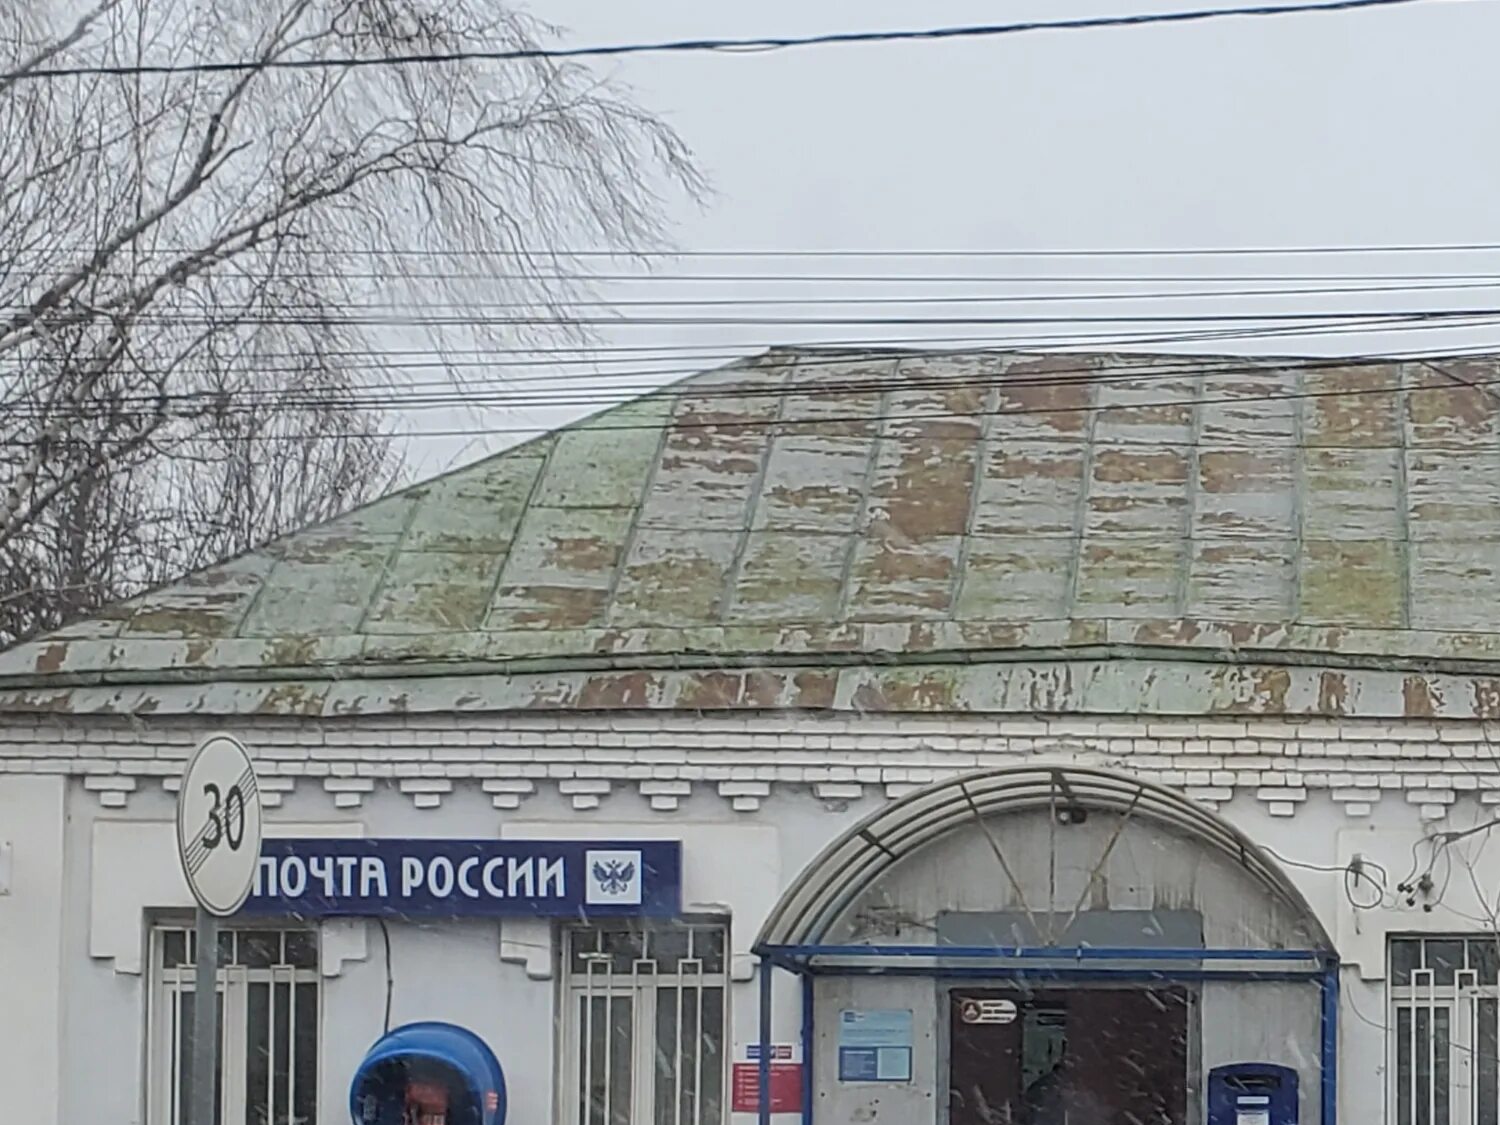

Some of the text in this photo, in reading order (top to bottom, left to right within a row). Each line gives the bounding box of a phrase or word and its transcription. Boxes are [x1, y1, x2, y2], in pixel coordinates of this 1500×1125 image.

[203, 783, 244, 851] 30
[252, 855, 566, 898] ПОЧТА РОССИИ
